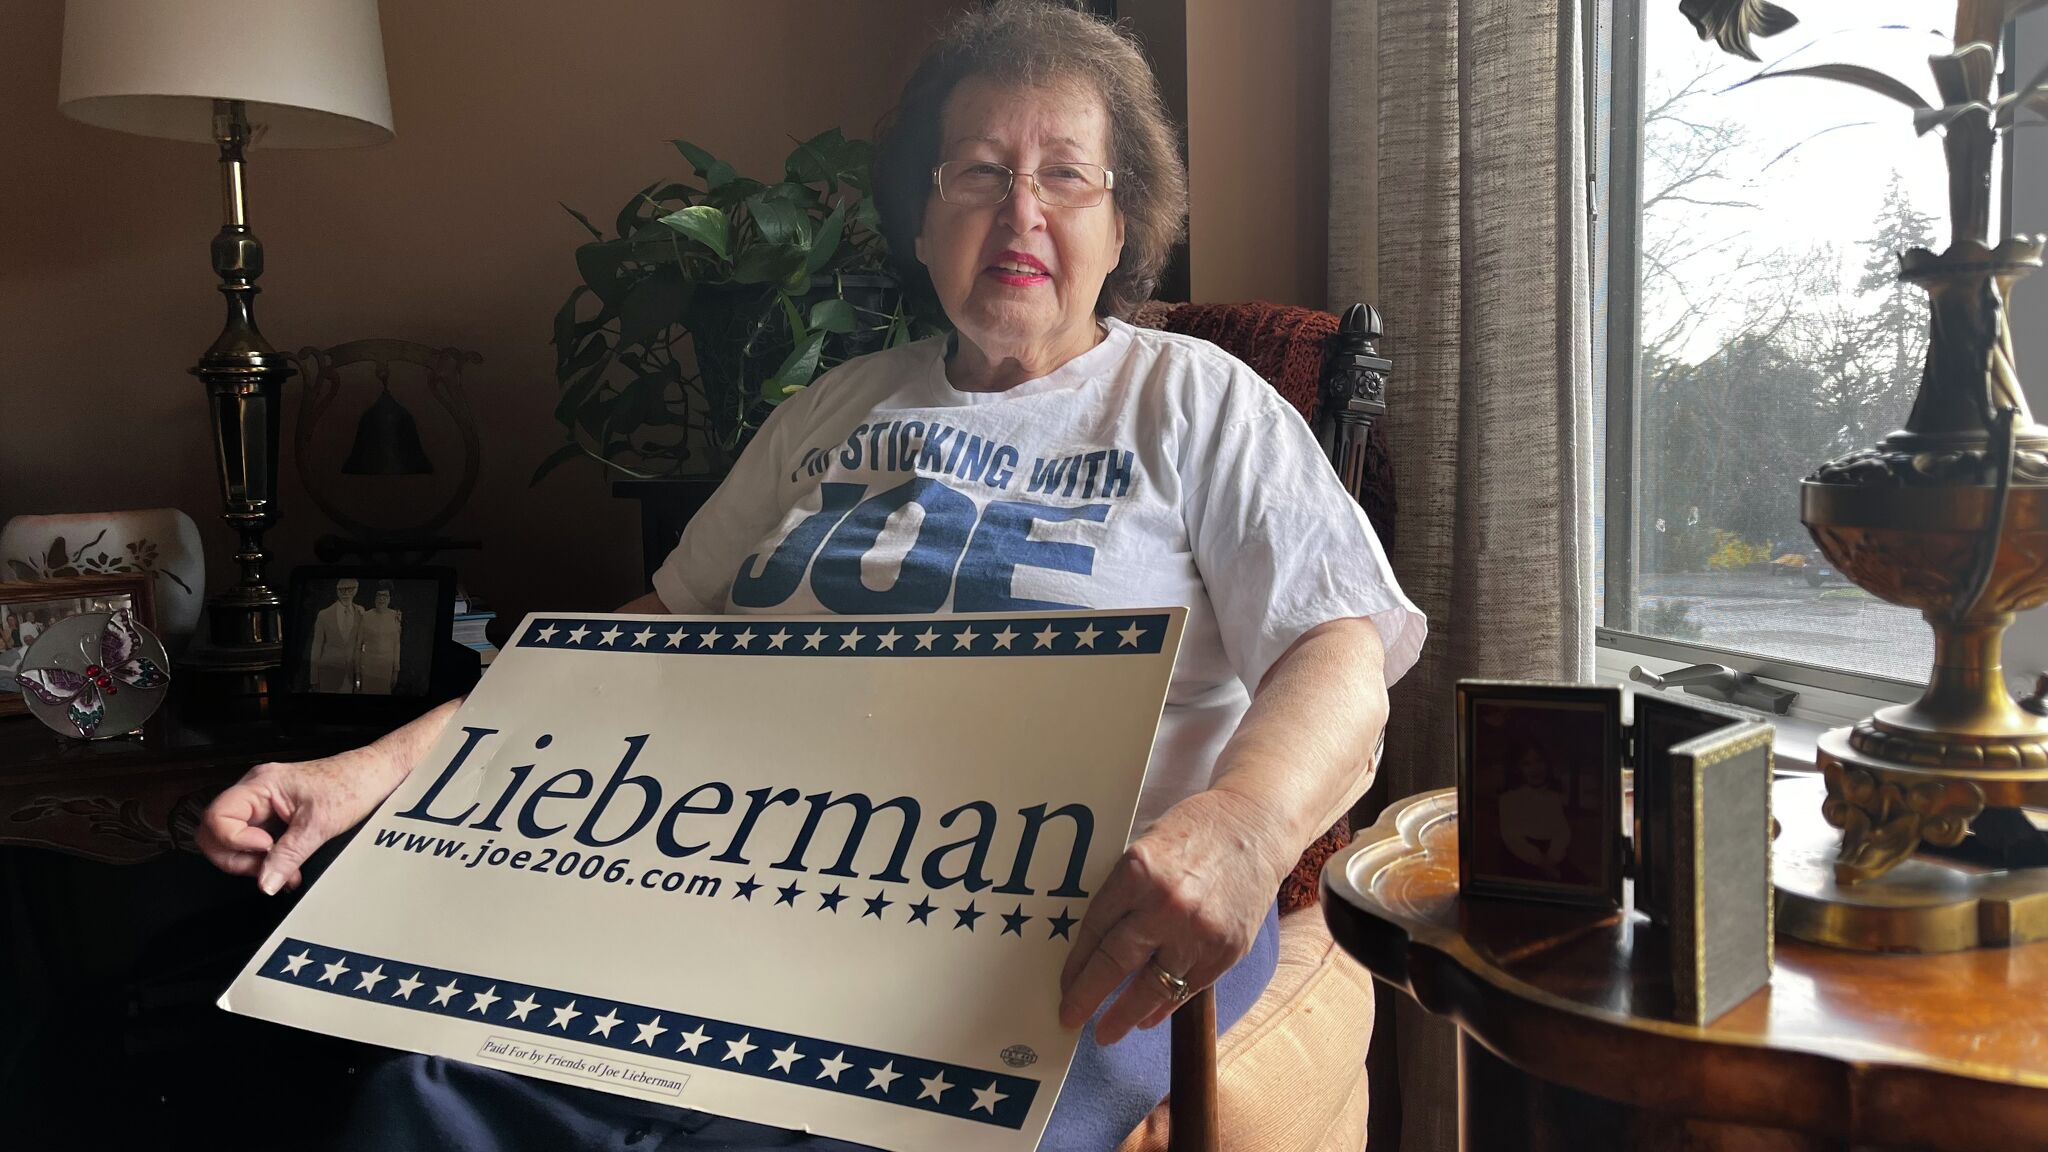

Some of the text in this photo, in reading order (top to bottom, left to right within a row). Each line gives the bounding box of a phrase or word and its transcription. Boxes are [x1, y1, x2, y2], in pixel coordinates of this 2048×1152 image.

[791, 421, 1134, 498] IM STICKING WITH
[732, 477, 1111, 613] JOE
[395, 726, 1095, 899] Lieberman
[372, 824, 722, 898] www.joe2006.com
[483, 1041, 682, 1091] Paid For by Friends of Joe Lieberman
